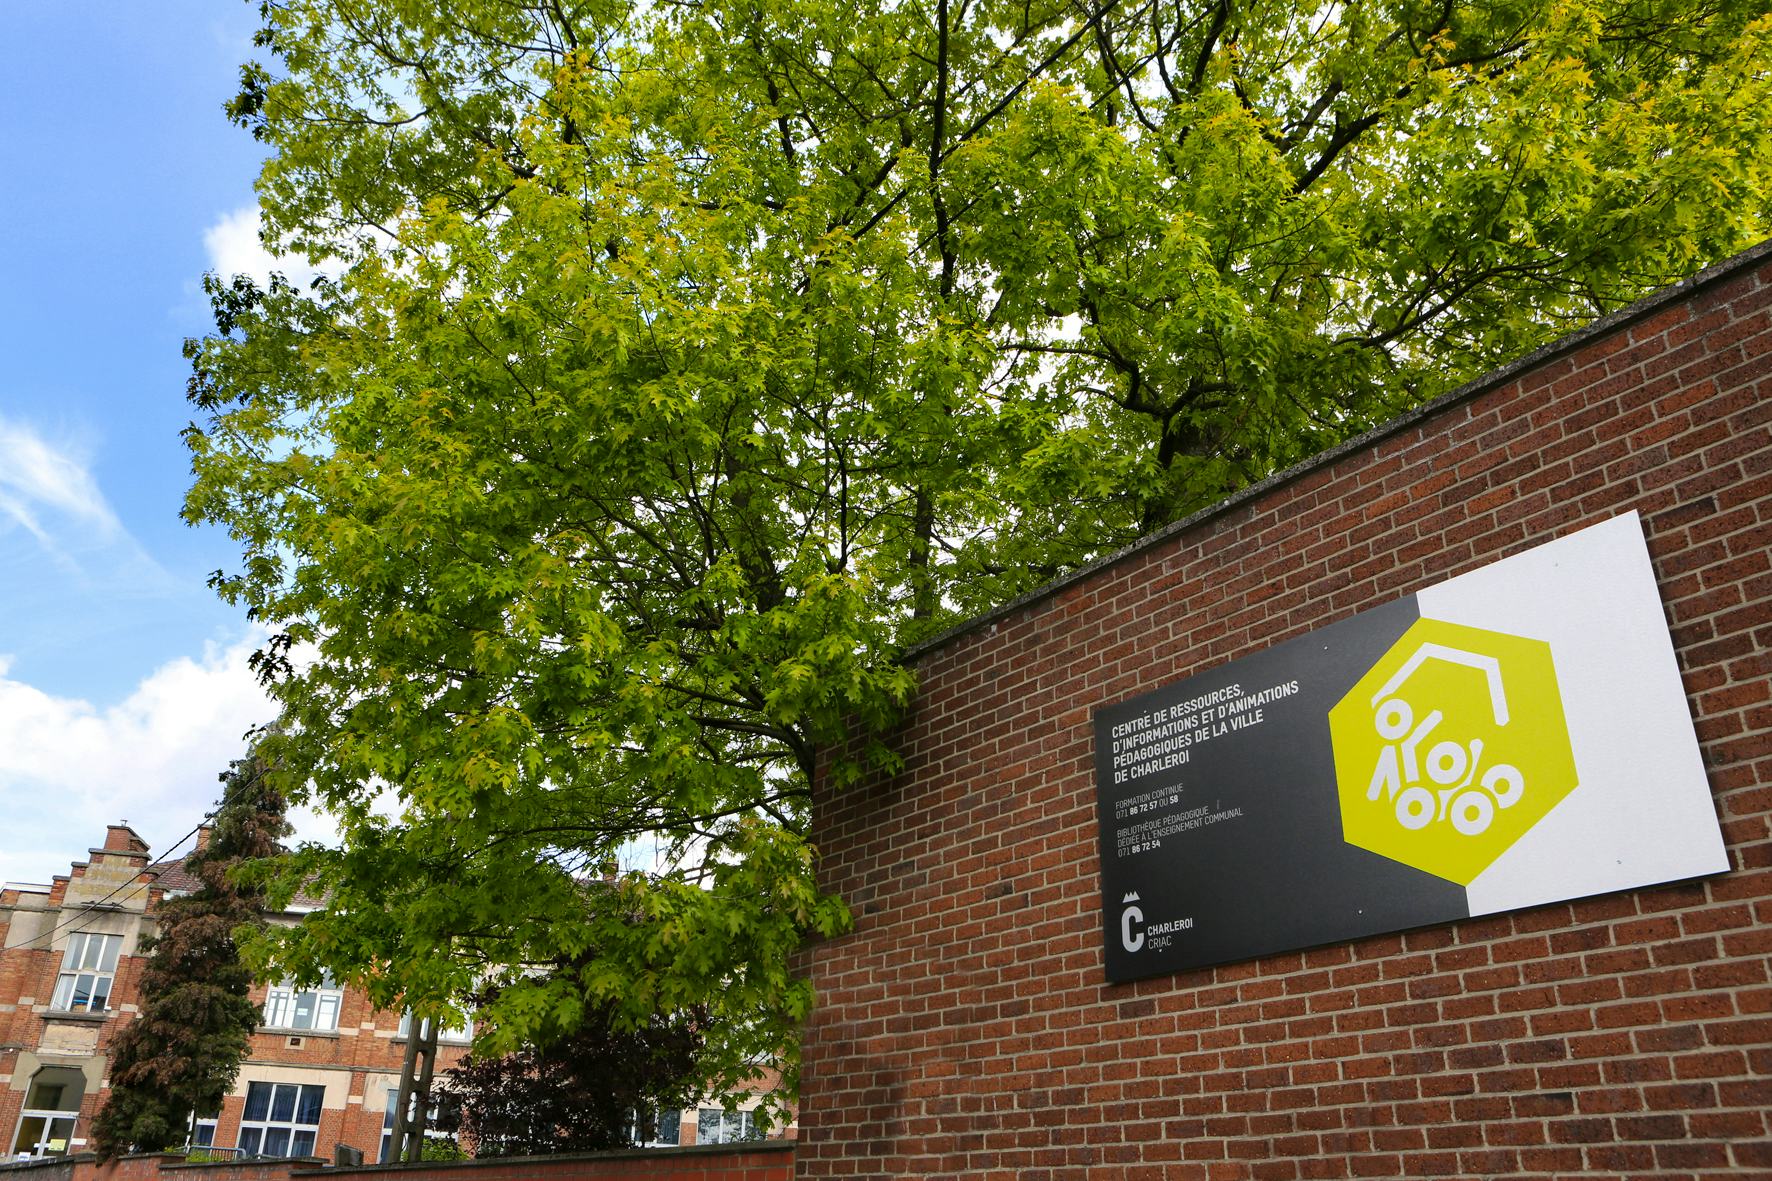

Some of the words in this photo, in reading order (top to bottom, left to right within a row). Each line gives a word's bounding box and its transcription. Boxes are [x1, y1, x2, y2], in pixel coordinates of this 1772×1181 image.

[1112, 716, 1150, 739] CENTRE
[1154, 709, 1167, 725] DE
[1171, 683, 1245, 719] RESSOURCES,
[1113, 715, 1198, 753] D'INFORMATIONS
[1201, 709, 1215, 724] ET
[1218, 681, 1299, 718] D'ANIMATIONS
[1114, 734, 1192, 768] PÉDAGOGIQUES
[1195, 727, 1210, 743] DE
[1213, 721, 1228, 737] LA
[1231, 709, 1264, 731] VILLE
[1114, 768, 1128, 784] DE
[1131, 750, 1190, 780] CHARLEROI
[1115, 792, 1150, 810] FORMATION
[1151, 783, 1183, 801] CONTINUE
[1116, 809, 1128, 819] 071
[1130, 807, 1138, 815] 86
[1140, 804, 1148, 813] 72
[1150, 801, 1157, 810] 57
[1159, 798, 1169, 807] OU
[1170, 794, 1179, 804] 58
[1117, 819, 1161, 838] BIBLIOTHÈQUE
[1163, 806, 1209, 826] PÉDAGOGIQUE
[1117, 834, 1139, 848] DÉDIÉE
[1141, 832, 1146, 841] À
[1148, 818, 1203, 840] L'ENSEIGNEMENT
[1204, 808, 1244, 825] COMMUNAL
[1118, 847, 1130, 857] 071
[1132, 845, 1140, 853] 86
[1142, 842, 1150, 851] 72
[1152, 839, 1160, 849] 54
[1147, 918, 1193, 936] CHARLEROI
[1148, 935, 1172, 949] CRIAC
